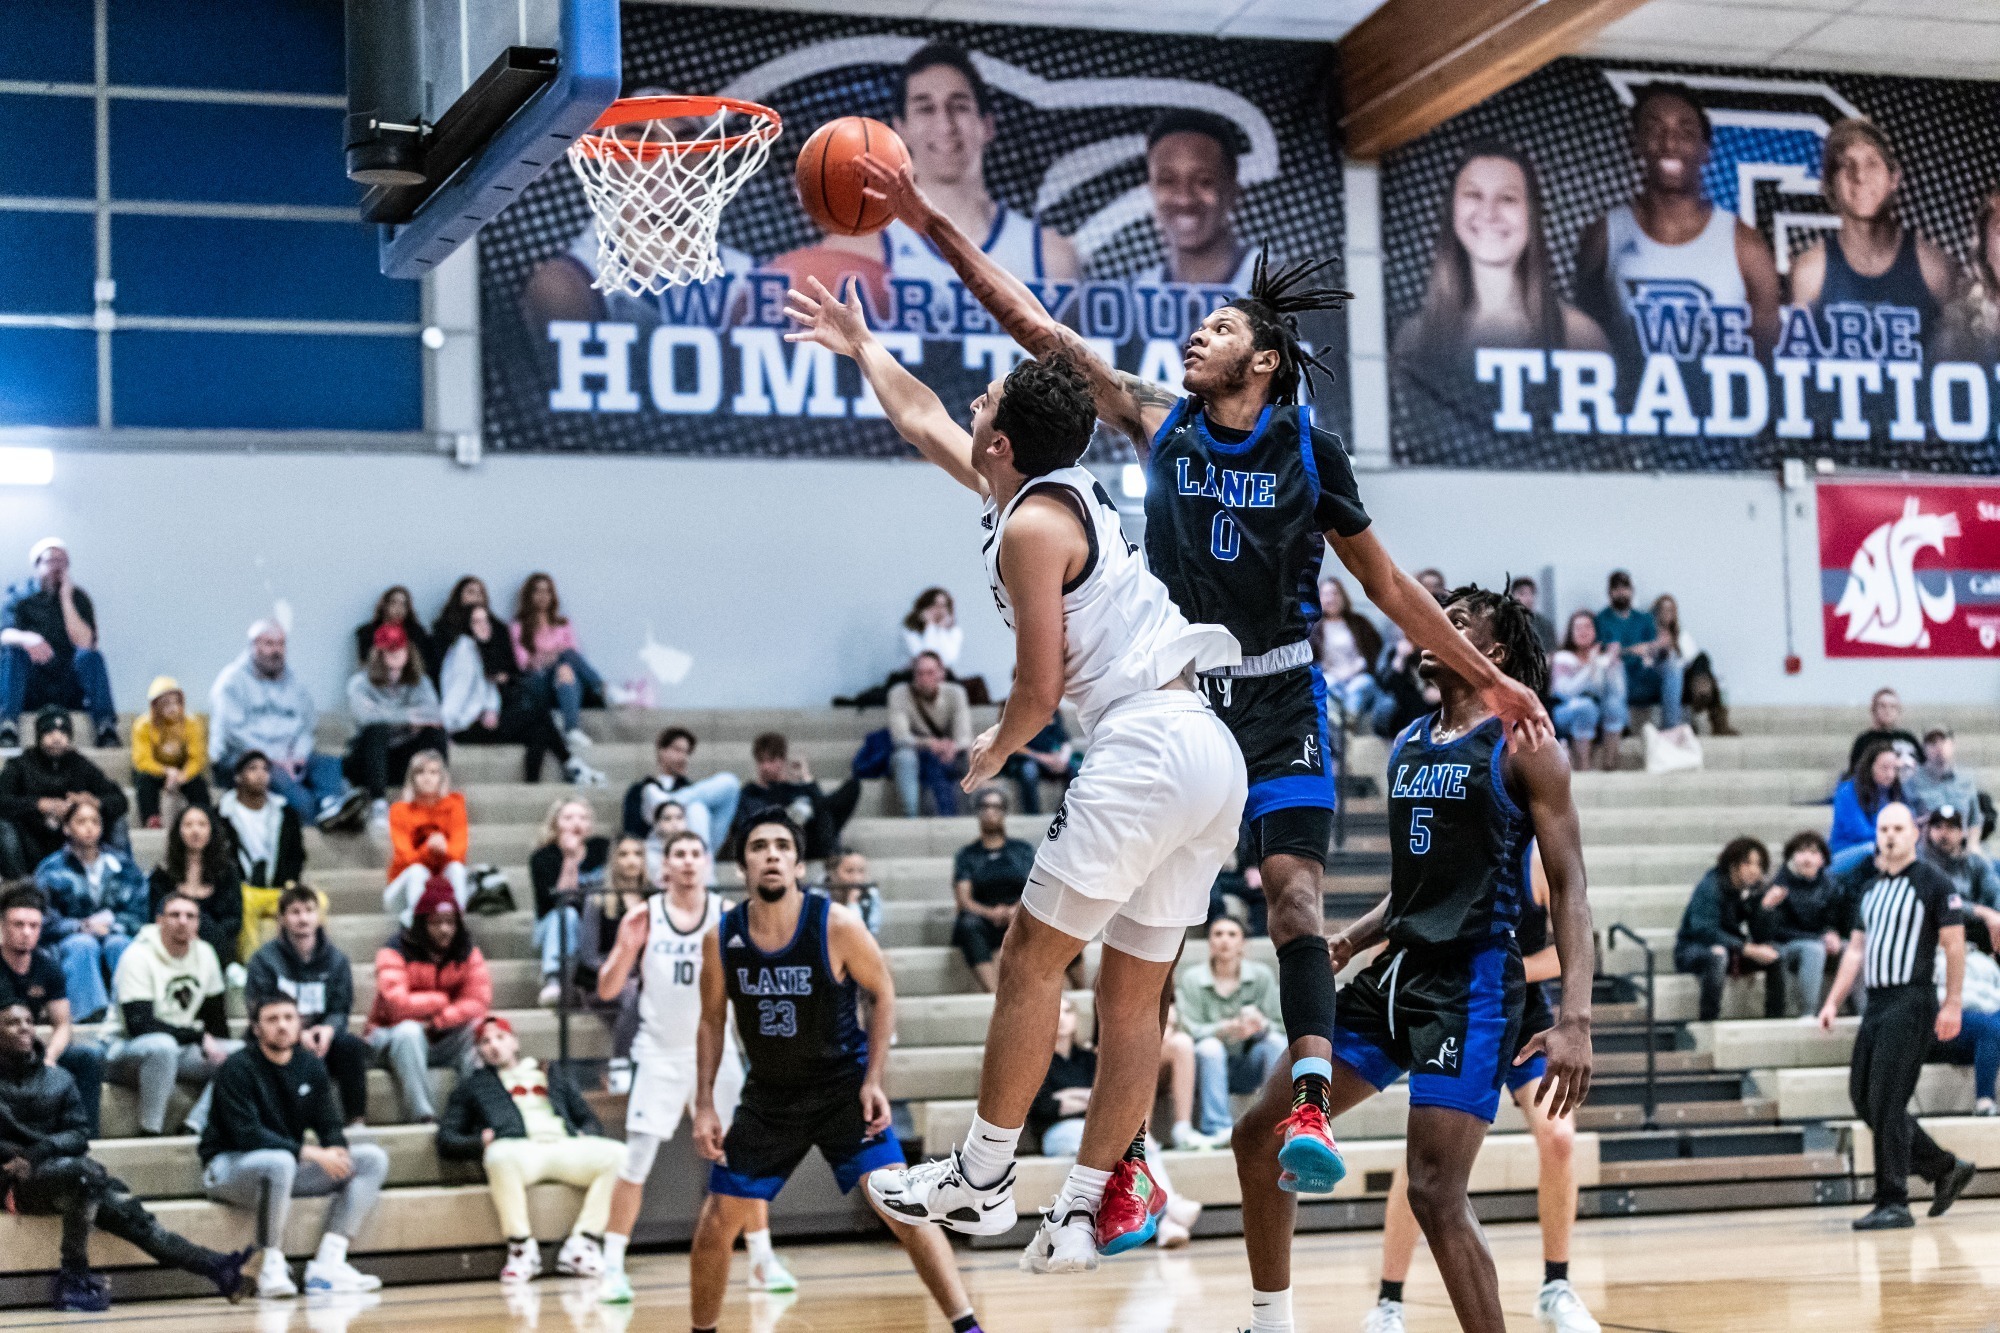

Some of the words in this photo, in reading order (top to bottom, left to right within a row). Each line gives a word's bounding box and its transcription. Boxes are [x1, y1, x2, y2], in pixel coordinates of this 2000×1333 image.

[1023, 279, 1240, 344] YOU
[1631, 301, 1753, 360] WE
[1774, 303, 1923, 364] ARE
[1475, 349, 2000, 442] TRADITIO
[1176, 457, 1276, 508] LANE
[1210, 510, 1241, 562] 0
[1391, 764, 1471, 799] LANE
[1409, 807, 1434, 855] 5
[673, 959, 695, 986] 10
[737, 965, 812, 996] LANE
[758, 999, 797, 1037] 23
